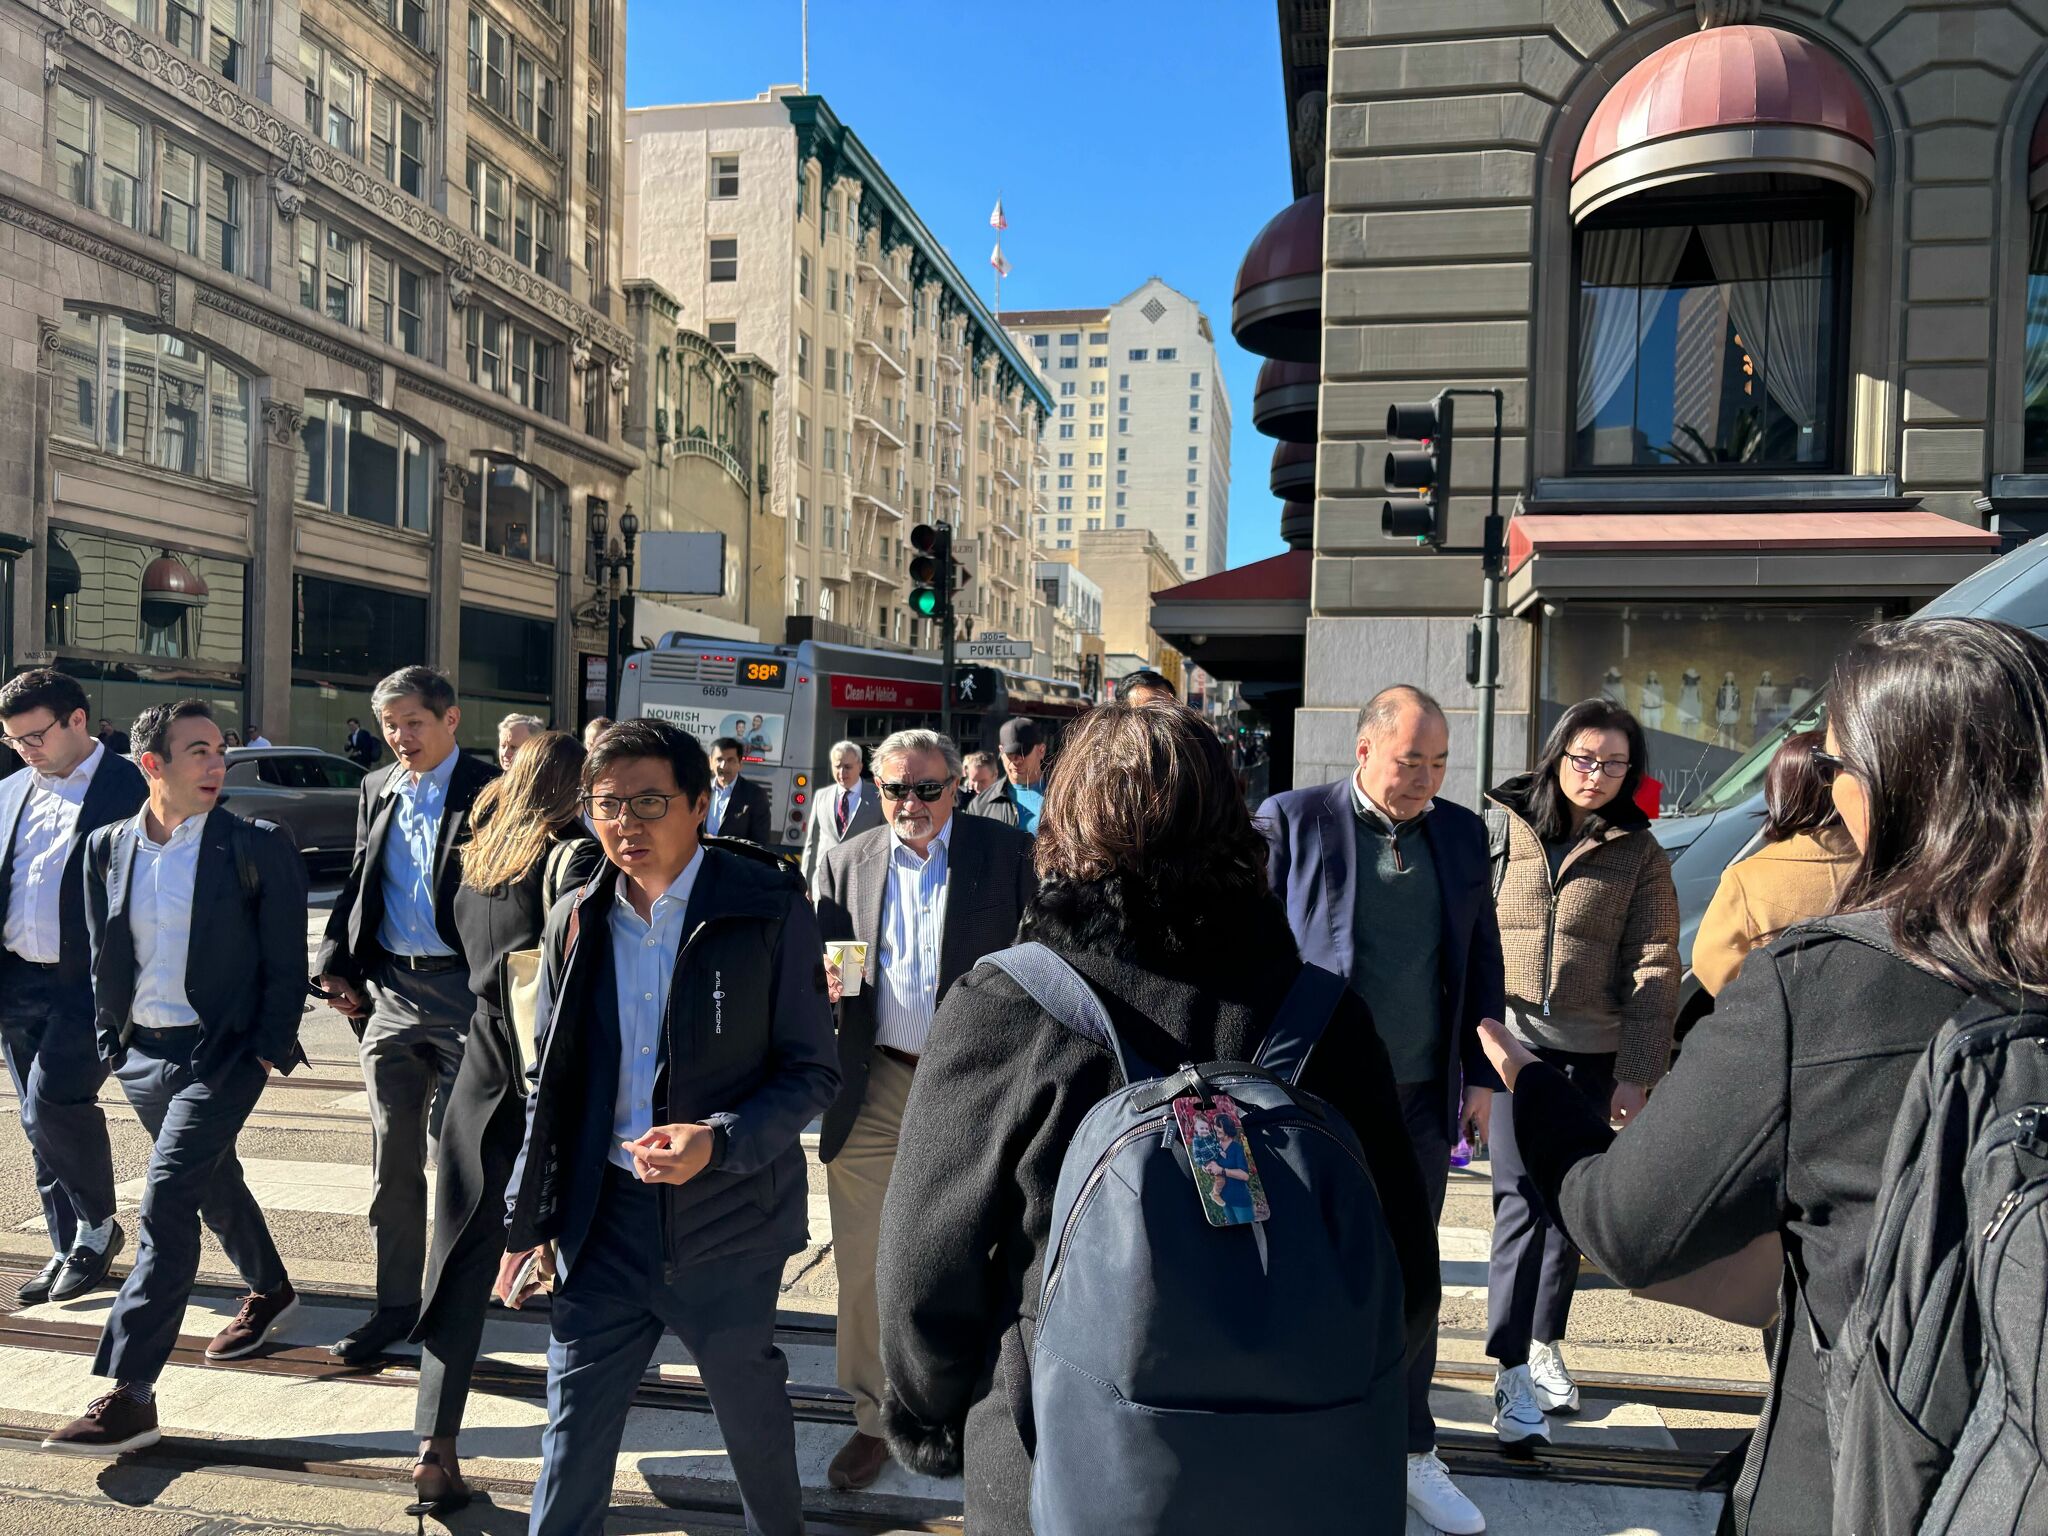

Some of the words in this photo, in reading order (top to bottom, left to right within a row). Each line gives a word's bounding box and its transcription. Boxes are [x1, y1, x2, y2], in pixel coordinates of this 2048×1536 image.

[970, 645, 1016, 656] POWELL
[747, 663, 778, 680] 38R
[702, 686, 728, 697] 6659
[844, 683, 865, 701] Clean
[865, 684, 875, 702] Air
[876, 685, 897, 703] Vehicle
[647, 708, 700, 722] NOURISH
[1655, 769, 1708, 794] NITY
